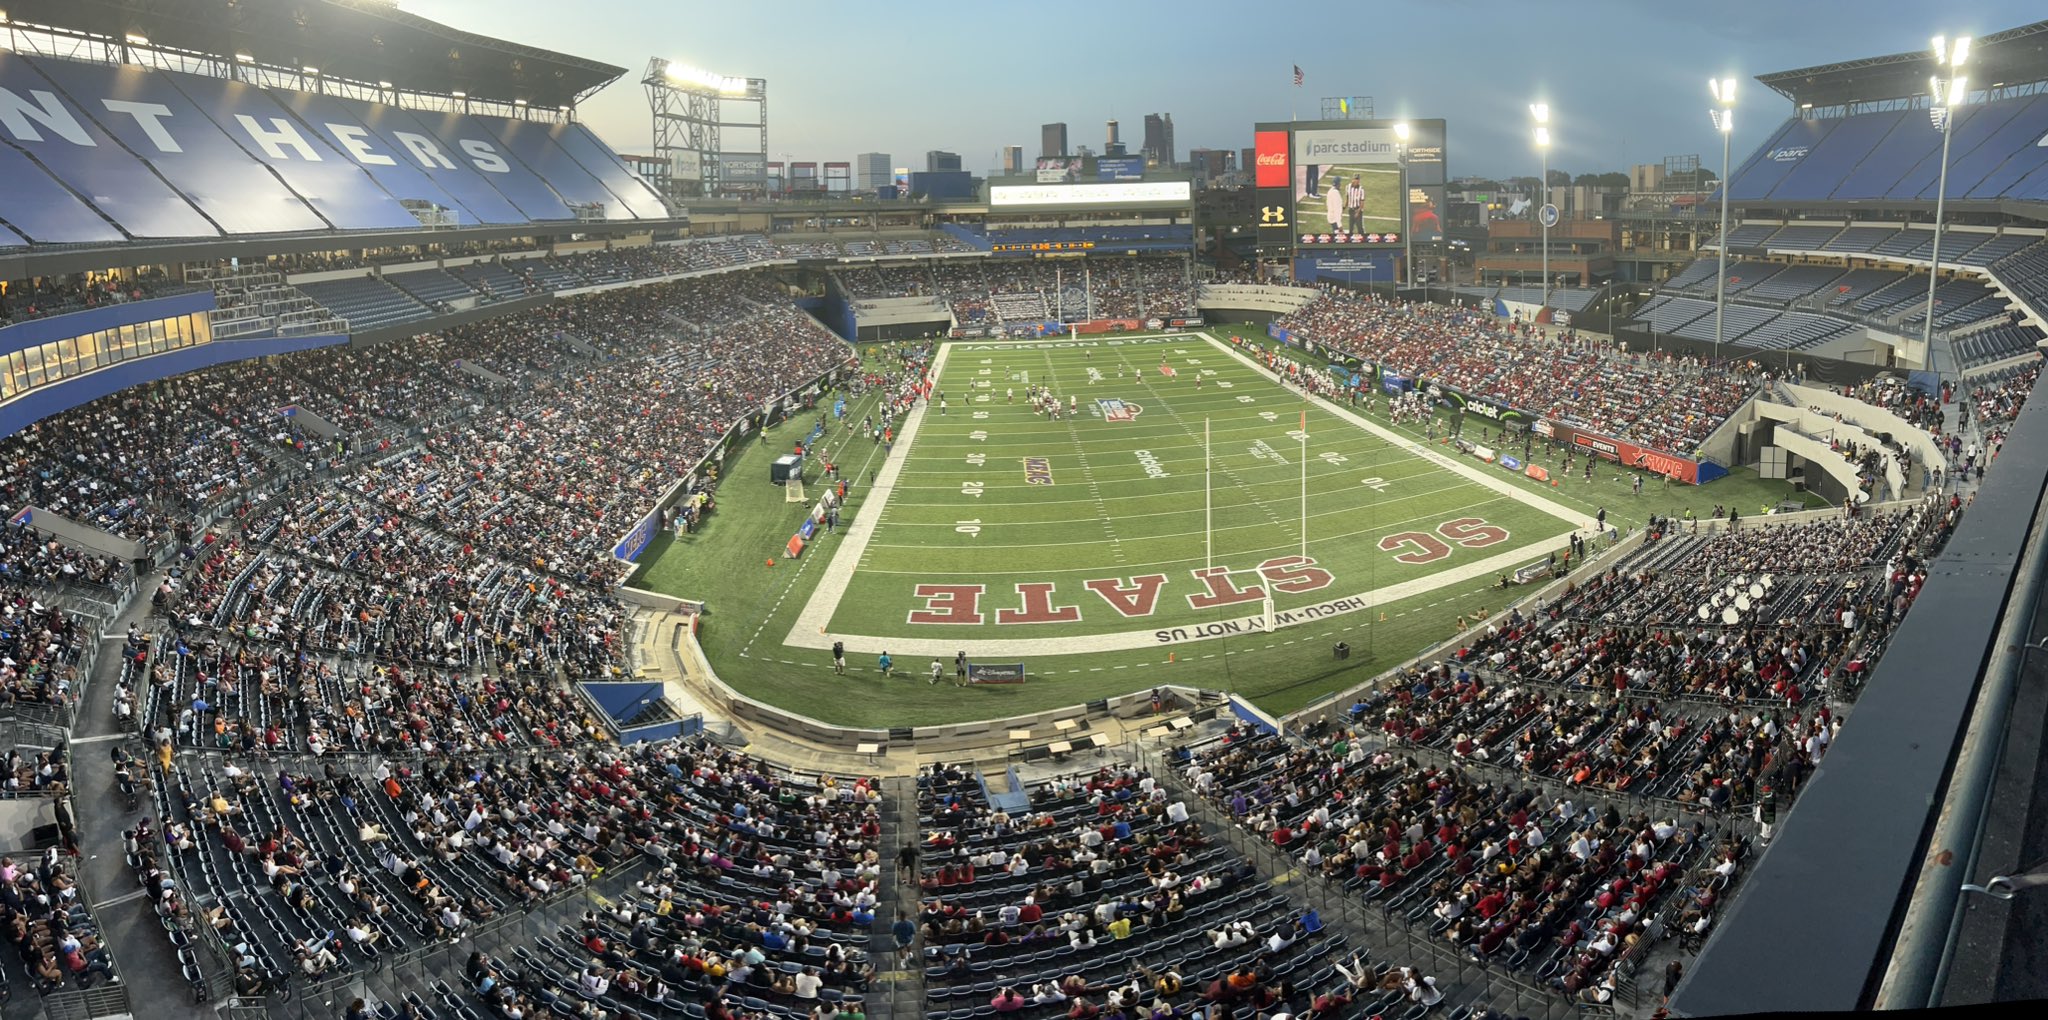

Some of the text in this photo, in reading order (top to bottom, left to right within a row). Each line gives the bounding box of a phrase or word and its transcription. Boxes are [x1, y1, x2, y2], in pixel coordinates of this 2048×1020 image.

[1313, 142, 1339, 156] parc
[1341, 140, 1391, 153] stadium
[723, 161, 765, 169] NORTHSIDE
[962, 336, 1197, 350] JACKSON STATE
[1466, 400, 1499, 419] cricket
[1592, 441, 1615, 453] EVENTS
[965, 453, 986, 464] 30
[1133, 450, 1171, 478] cricket
[1645, 454, 1683, 478] SWAC
[961, 481, 984, 495] 20
[1361, 477, 1391, 490] 10
[956, 519, 981, 534] 10
[906, 517, 1511, 625] SC STATE
[1155, 628, 1188, 642] US
[1195, 621, 1242, 638] NOT
